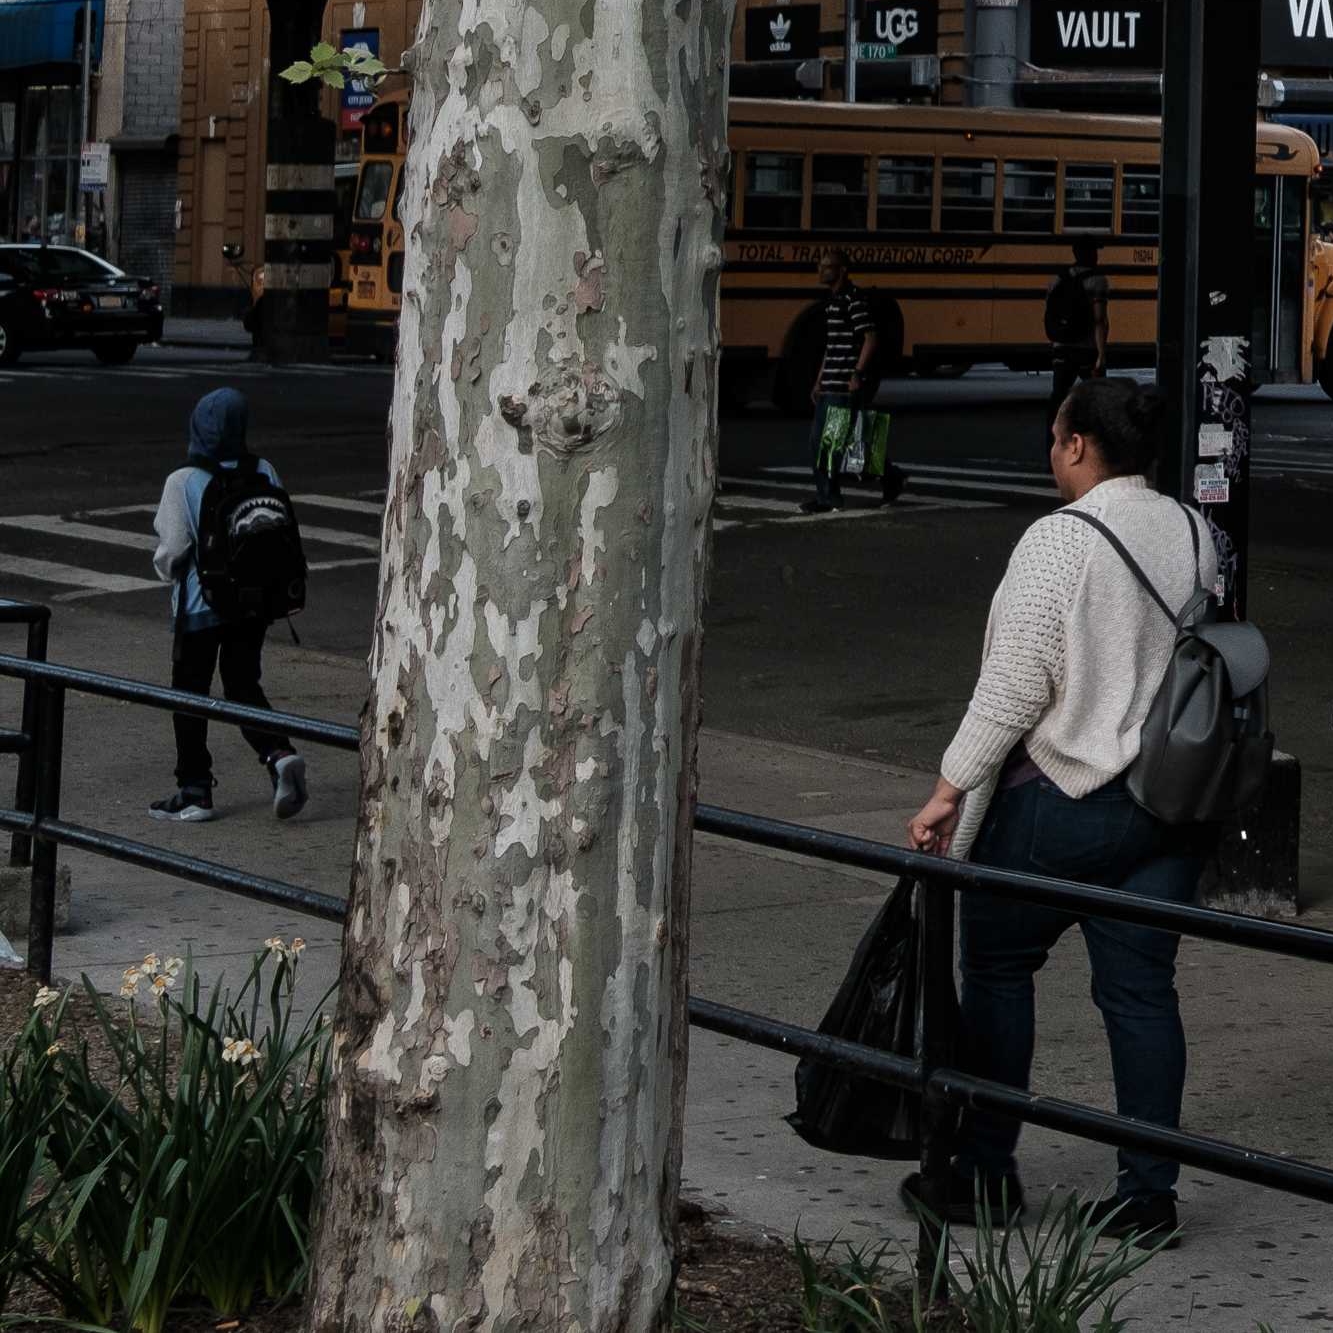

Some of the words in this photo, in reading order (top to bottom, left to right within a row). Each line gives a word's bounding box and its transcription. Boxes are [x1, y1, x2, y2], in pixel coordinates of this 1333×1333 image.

[875, 7, 919, 45] UGG
[1056, 10, 1141, 48] VAULT
[867, 44, 886, 59] 170
[738, 244, 784, 260] TOTAL
[792, 244, 926, 264] TRANPORTATION
